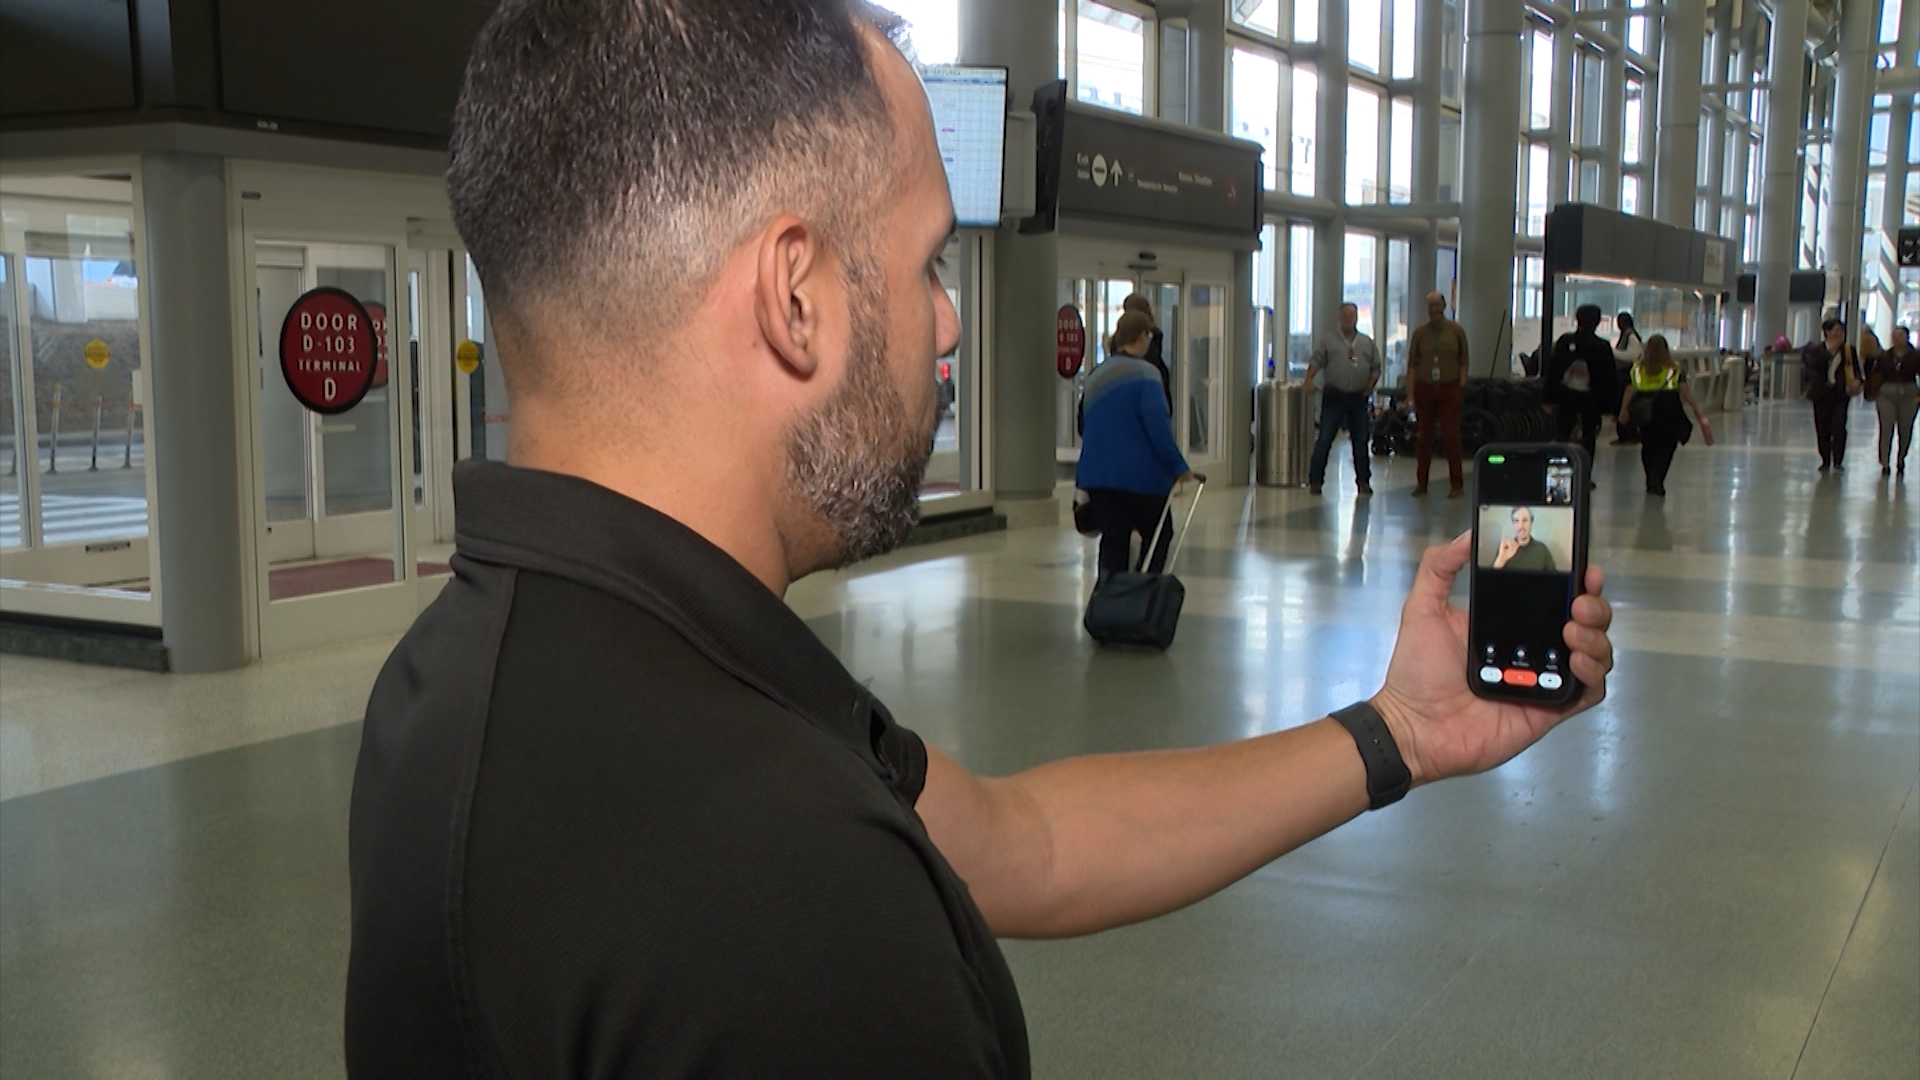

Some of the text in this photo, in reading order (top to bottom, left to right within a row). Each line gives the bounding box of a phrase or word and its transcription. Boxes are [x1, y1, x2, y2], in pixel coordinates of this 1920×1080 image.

[300, 311, 358, 332] DOOR
[298, 359, 361, 372] TERMINAL
[323, 377, 337, 402] D
